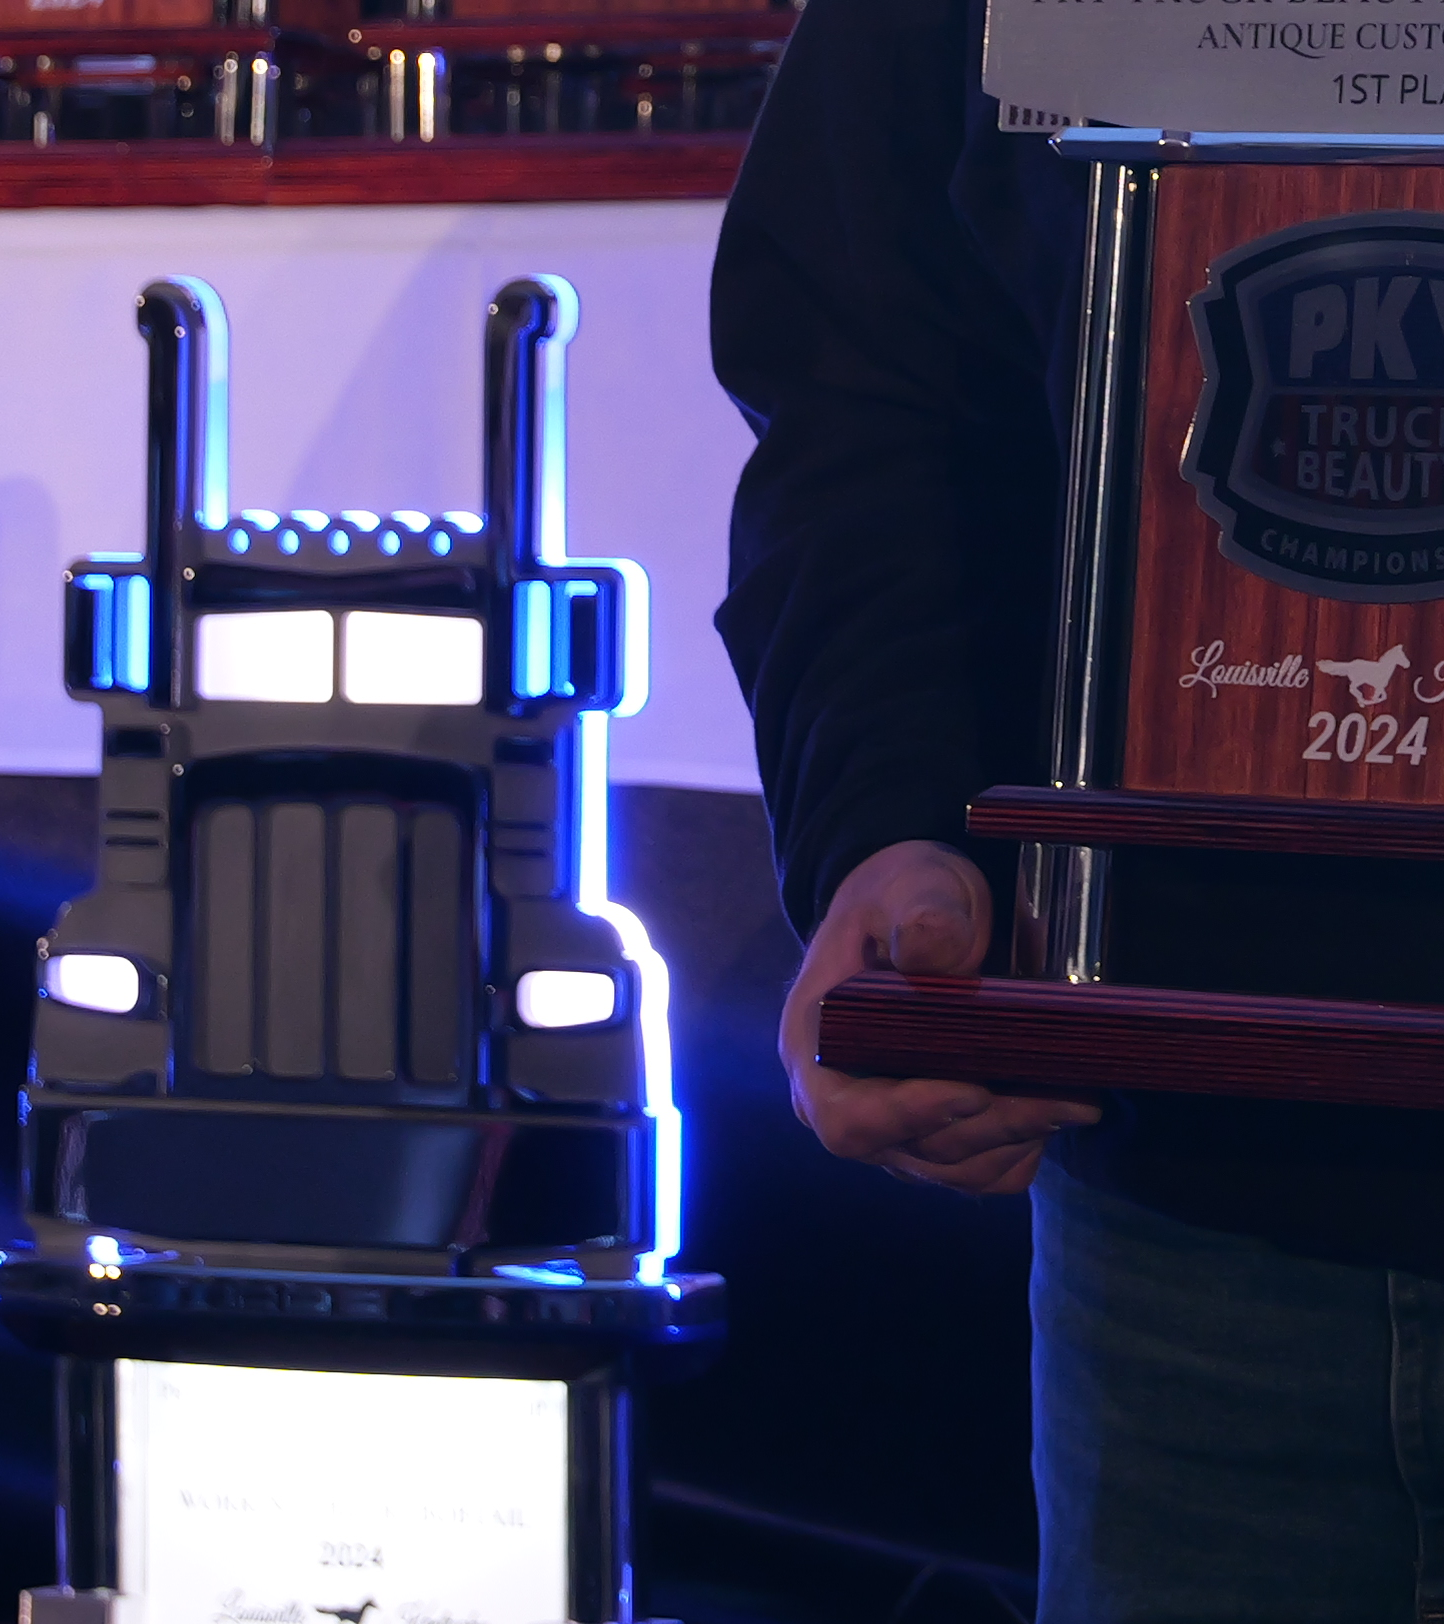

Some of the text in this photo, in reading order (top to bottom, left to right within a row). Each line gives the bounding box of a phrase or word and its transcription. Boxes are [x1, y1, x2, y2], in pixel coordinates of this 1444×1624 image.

[1196, 22, 1347, 59] ANTIQUE
[1331, 73, 1390, 105] 1ST
[1178, 640, 1310, 699] Louisville
[1302, 711, 1430, 767] 2024
